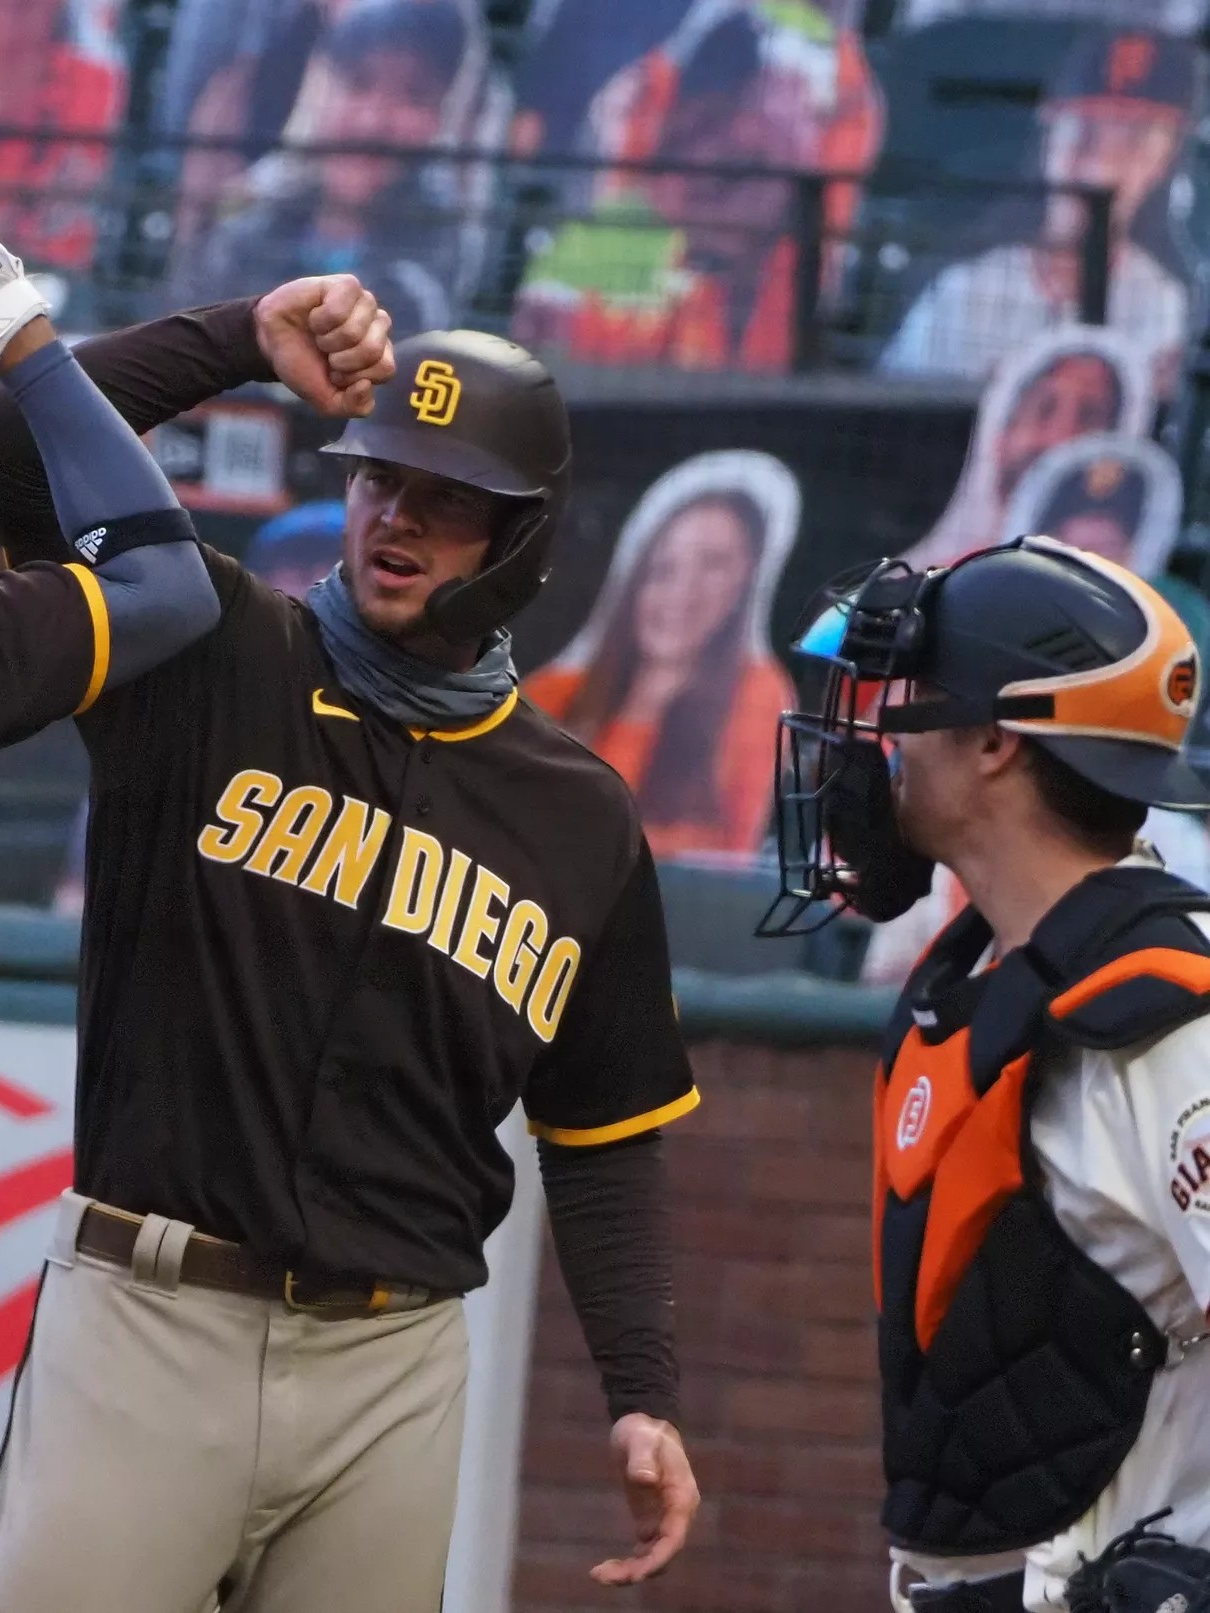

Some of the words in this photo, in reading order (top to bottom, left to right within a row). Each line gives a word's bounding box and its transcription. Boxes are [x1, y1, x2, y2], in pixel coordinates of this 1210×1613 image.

[410, 359, 461, 426] SD
[197, 769, 392, 909] SAN
[381, 826, 581, 1042] DIEGO
